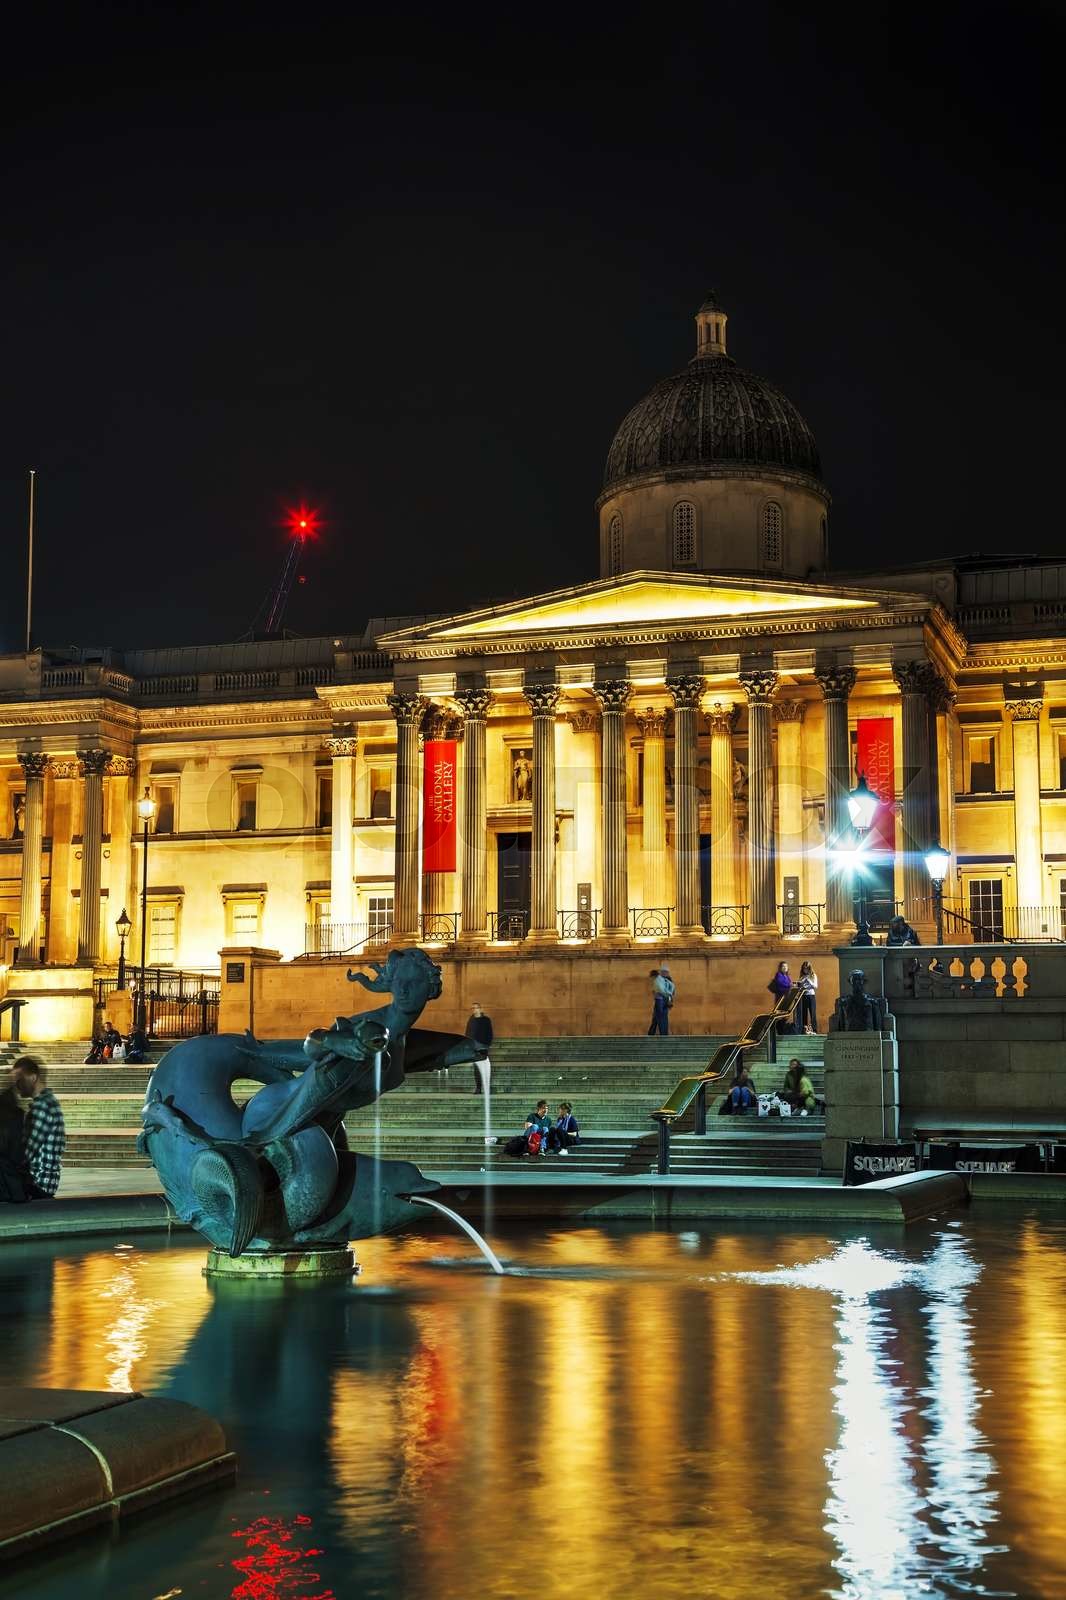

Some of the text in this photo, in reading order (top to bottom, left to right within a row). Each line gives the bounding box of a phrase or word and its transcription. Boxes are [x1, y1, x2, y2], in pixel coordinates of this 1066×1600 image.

[433, 760, 443, 823] NATIONAL
[443, 761, 453, 823] GALLERY
[879, 739, 890, 806] GALLERY
[853, 1155, 916, 1175] SQUARE
